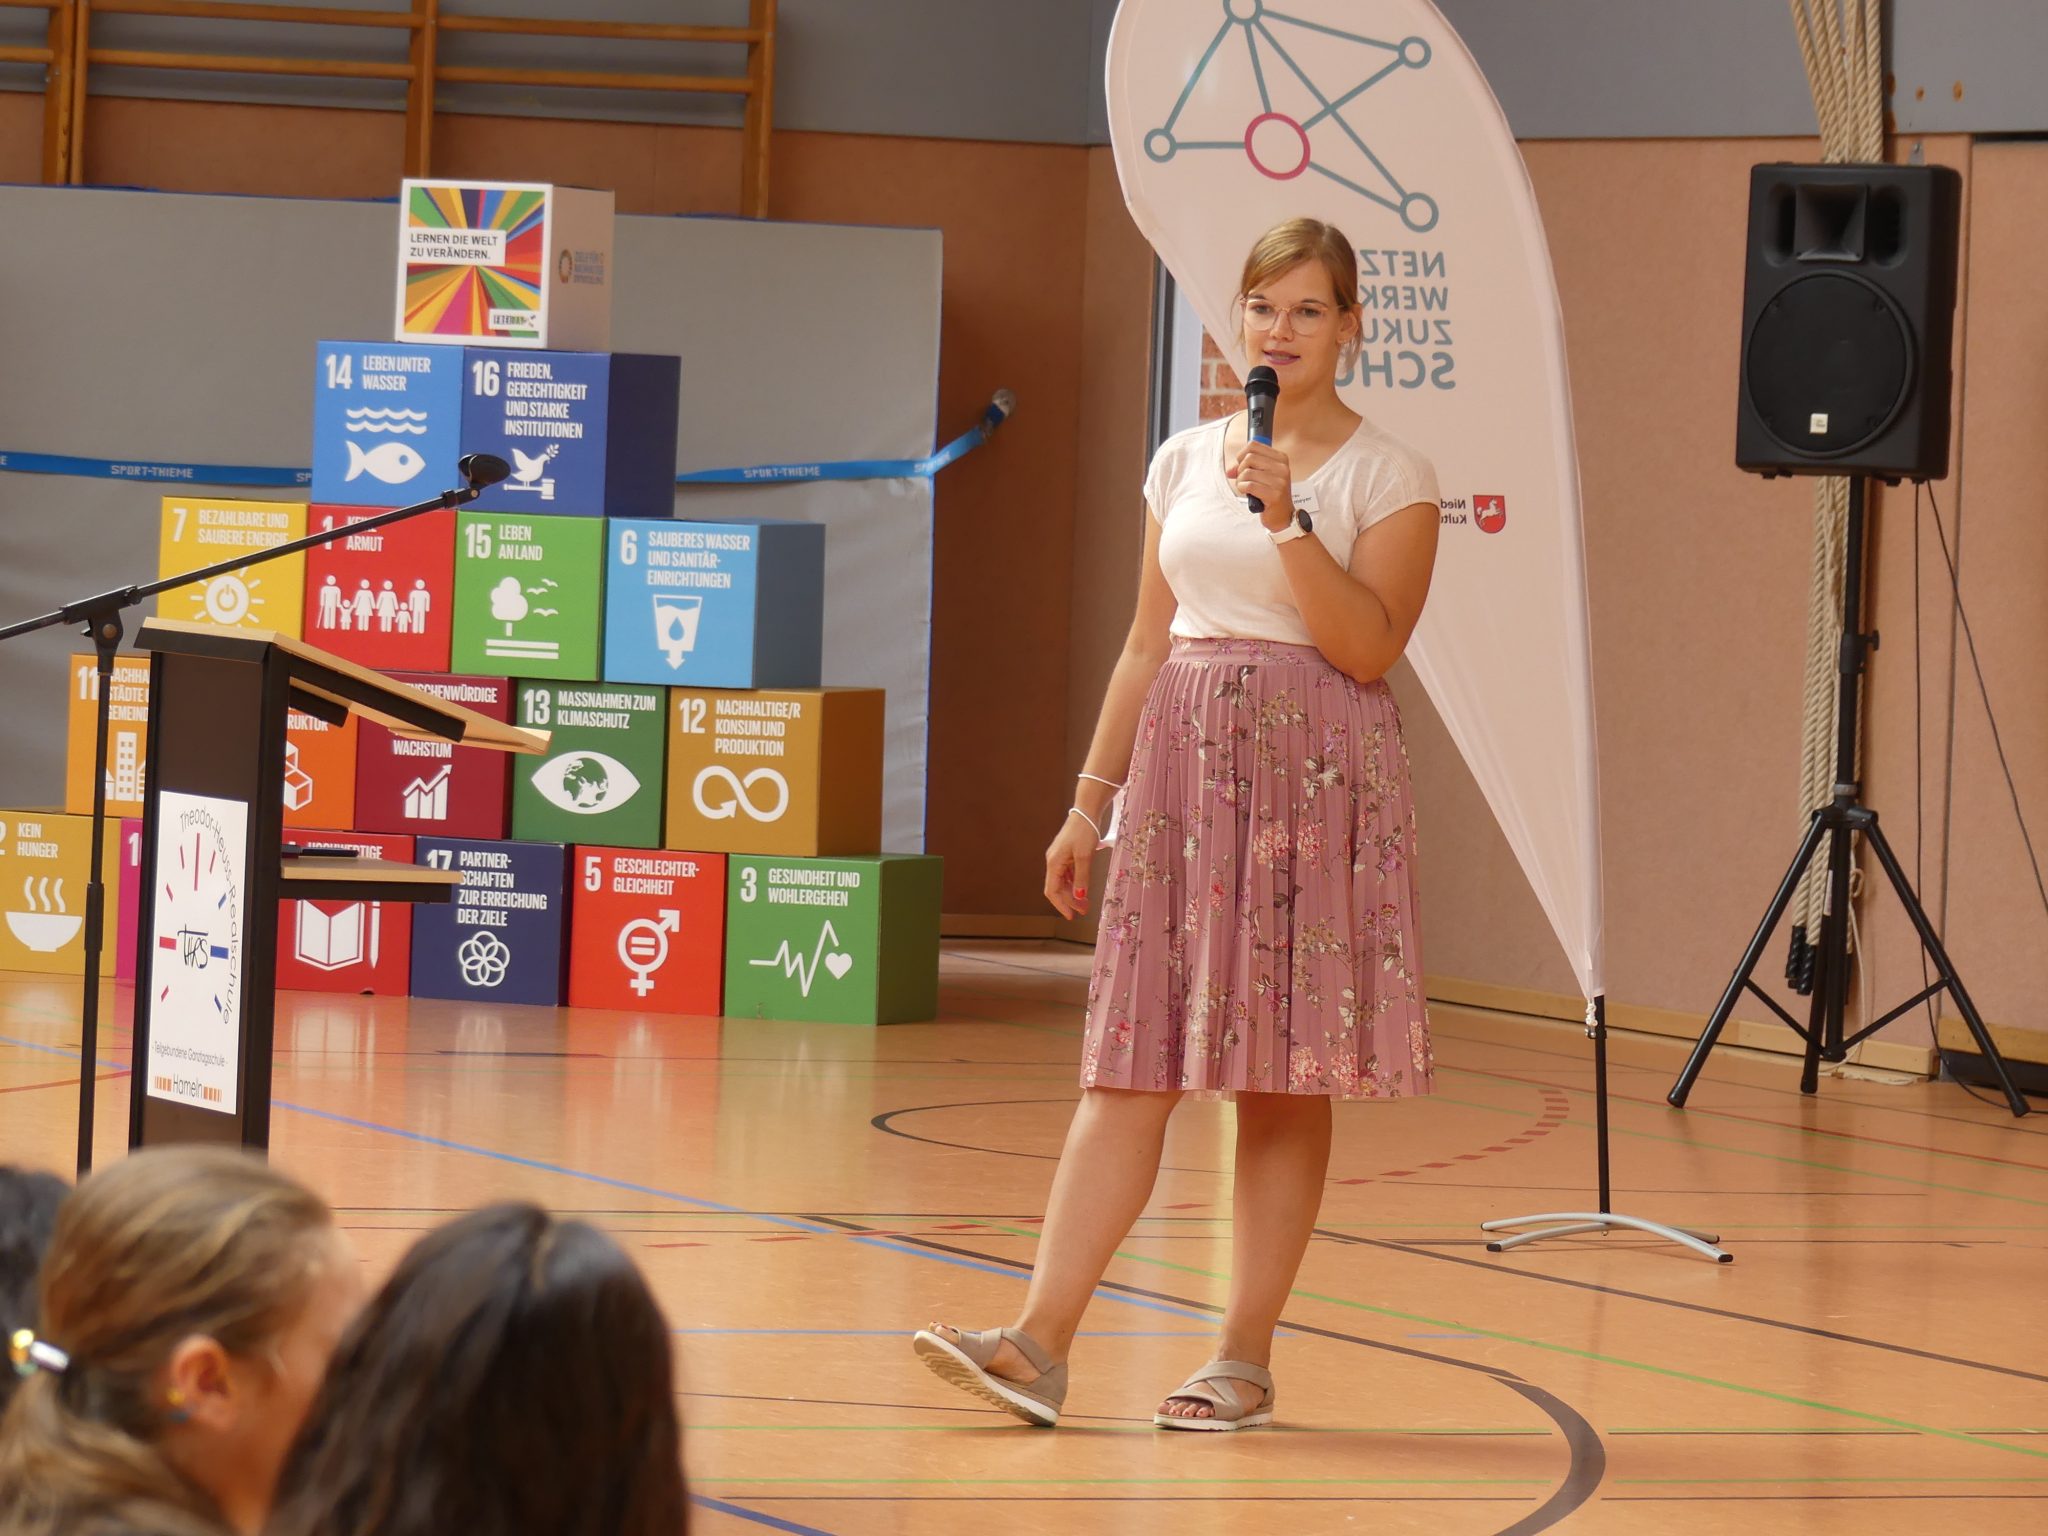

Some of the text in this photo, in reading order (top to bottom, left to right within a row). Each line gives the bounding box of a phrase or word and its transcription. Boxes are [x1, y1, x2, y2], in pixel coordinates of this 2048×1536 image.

[410, 234, 498, 246] LERNEN DIE WELT
[410, 246, 491, 259] ZU VERÄNDERN.
[326, 354, 352, 390] 14
[363, 355, 431, 373] LEBEN UNTER
[507, 362, 553, 380] FRIEDEN,
[362, 374, 407, 391] WASSER
[472, 360, 500, 396] 16
[506, 382, 588, 400] GERECHTIGKEIT
[506, 401, 570, 418] UND STARKE
[505, 420, 583, 438] INSTITUTIONEN
[112, 465, 193, 478] SPORT-THIEME
[744, 466, 820, 478] SPORT-THIEME
[173, 508, 188, 542] 7
[198, 509, 288, 528] BEZAHLBARE UND
[198, 528, 288, 547] SAUBERE ENERGIE
[466, 523, 492, 558] 15
[499, 524, 532, 541] LEBEN
[648, 531, 750, 551] SAUBERES WASSER
[346, 535, 384, 552] ARMUT
[498, 544, 543, 561] AN LAND
[620, 530, 638, 565] 6
[648, 550, 722, 569] UND SANITÄR-
[647, 570, 731, 589] EINRICHTUNGEN
[78, 666, 100, 700] 11
[110, 667, 150, 684] ACHHA
[524, 689, 550, 725] 13
[558, 690, 656, 712] MASSNAHMEN ZUM
[716, 699, 801, 720] NACHHALTIGE/R
[288, 714, 328, 732] RUKTUR
[557, 710, 630, 729] KLIMASCHUTZ
[680, 698, 706, 734] 12
[715, 719, 786, 737] KONSUM UND
[392, 740, 452, 758] WACHSTUM
[714, 738, 784, 757] PRODUKTION
[17, 822, 42, 838] KEIN
[16, 841, 58, 859] HUNGER
[460, 850, 512, 869] PARTNER-
[584, 856, 602, 892] 5
[614, 857, 700, 878] GESCHLECHTER-
[460, 870, 514, 889] SCHAFTEN
[613, 877, 674, 896] GLEICHHEIT
[740, 866, 758, 902] 3
[768, 868, 860, 888] GESUNDHEIT UND
[458, 889, 548, 910] ZUR ERREICHUNG
[768, 887, 848, 907] WOHLERGEHEN
[457, 908, 508, 926] DER ZIELE
[172, 1073, 202, 1099] Hameln
